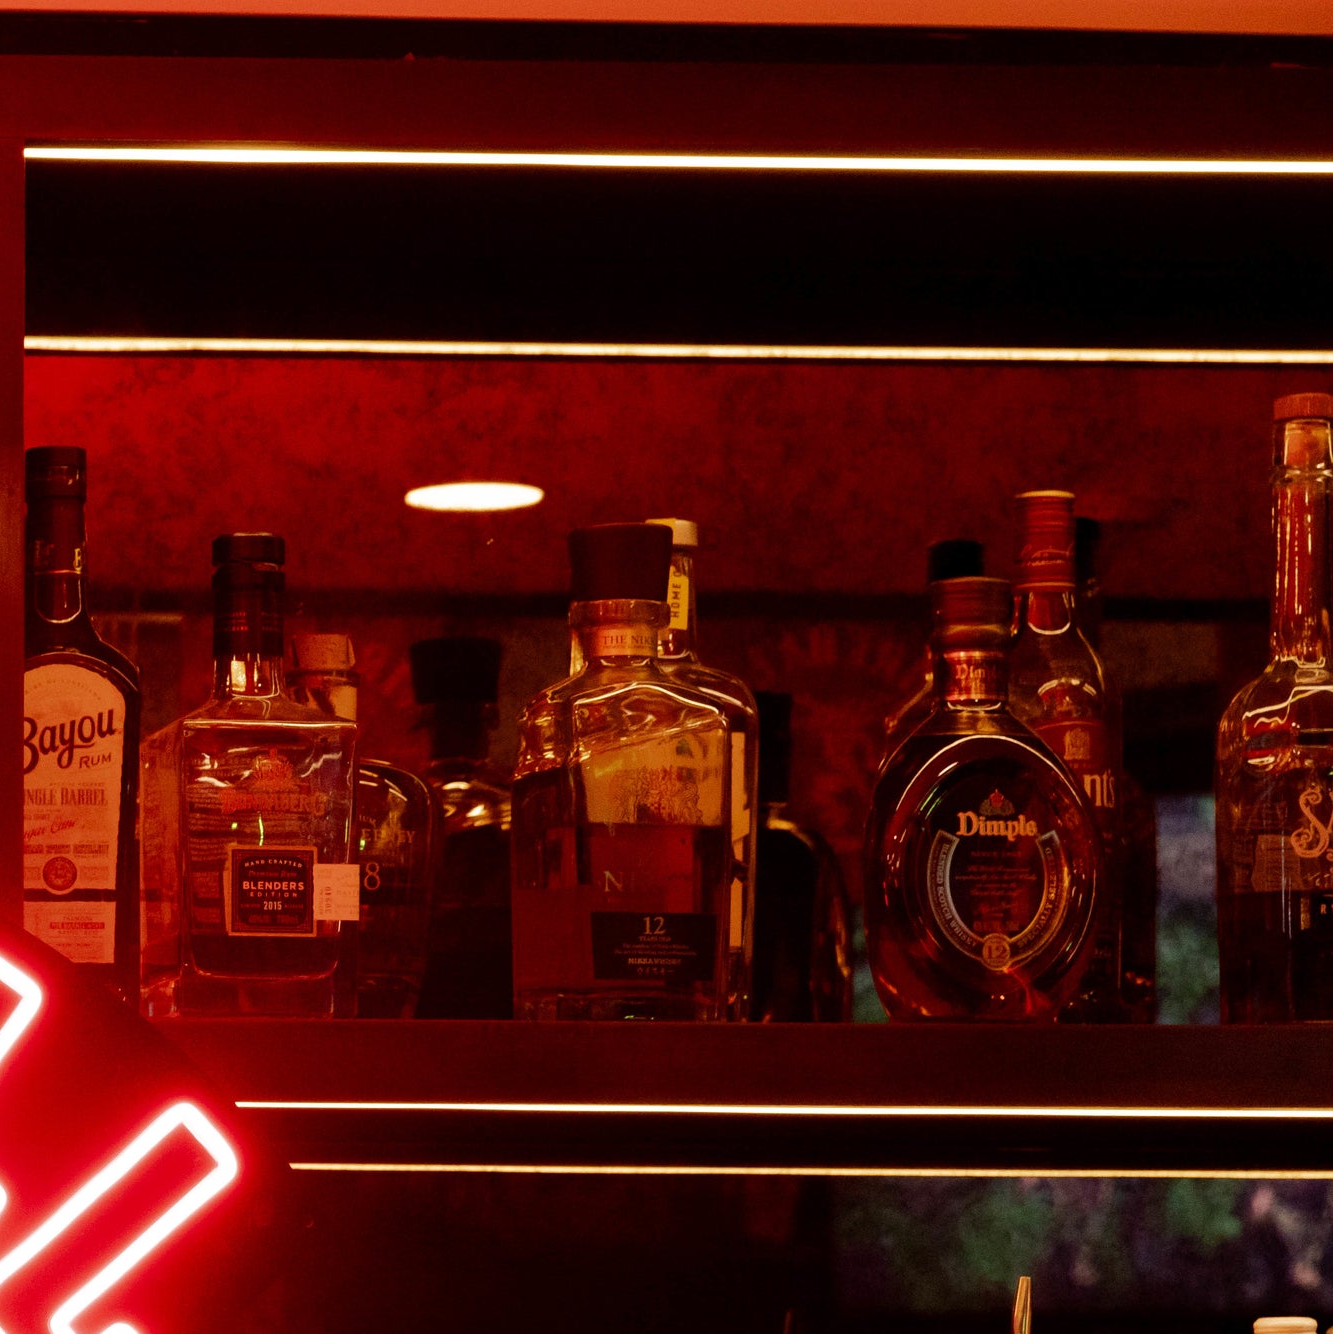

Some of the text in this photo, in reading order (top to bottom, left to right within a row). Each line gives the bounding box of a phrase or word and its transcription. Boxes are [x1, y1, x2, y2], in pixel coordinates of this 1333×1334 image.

[671, 583, 682, 619] HOME
[78, 752, 111, 769] RUM
[61, 787, 109, 806] BARREL
[955, 810, 1039, 843] Dimple
[364, 861, 381, 891] 8
[242, 880, 305, 892] BLENDERS
[250, 891, 298, 899] EDITION
[263, 901, 283, 911] 2015
[643, 915, 667, 935] 12
[986, 944, 1006, 959] 12
